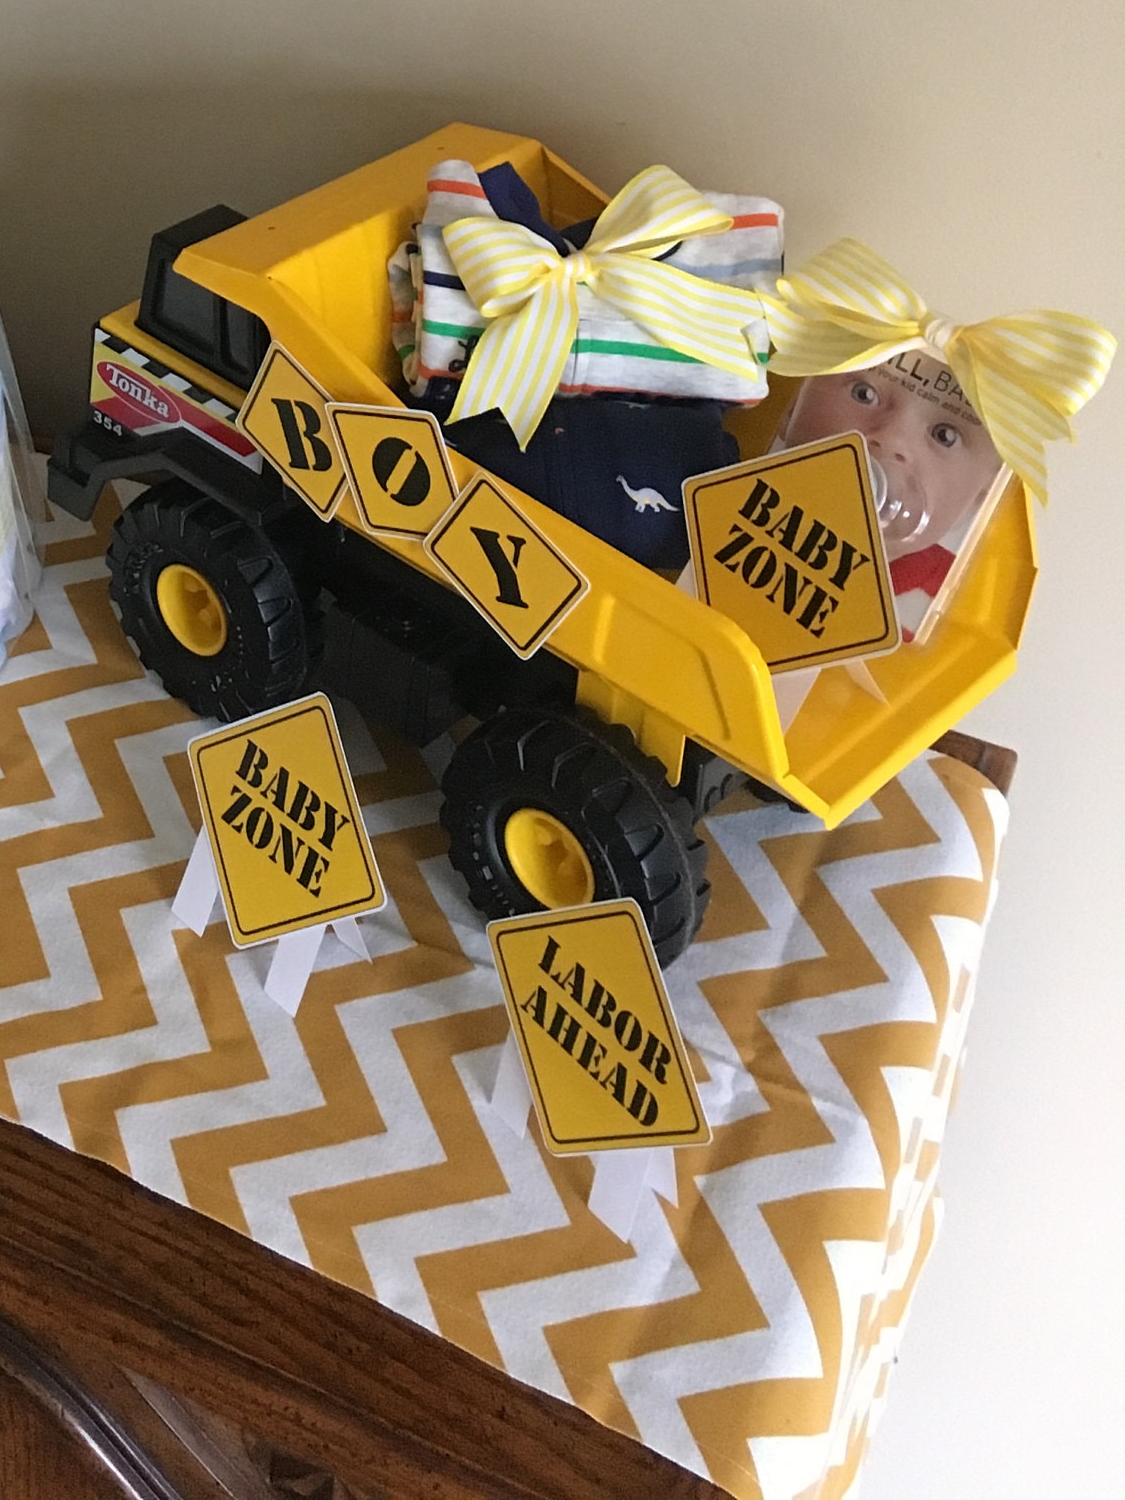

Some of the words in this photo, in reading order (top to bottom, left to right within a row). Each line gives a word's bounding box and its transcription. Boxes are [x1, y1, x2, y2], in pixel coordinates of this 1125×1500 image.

[93, 411, 123, 437] 354
[106, 363, 169, 418] Tonka
[901, 378, 916, 392] kid
[917, 387, 940, 404] calm
[713, 524, 839, 639] ZONE
[737, 477, 871, 592] BABY
[220, 784, 331, 899] ZONE
[235, 739, 351, 852] BABY
[520, 985, 660, 1128] AHEAD
[537, 935, 671, 1085] LABOR
